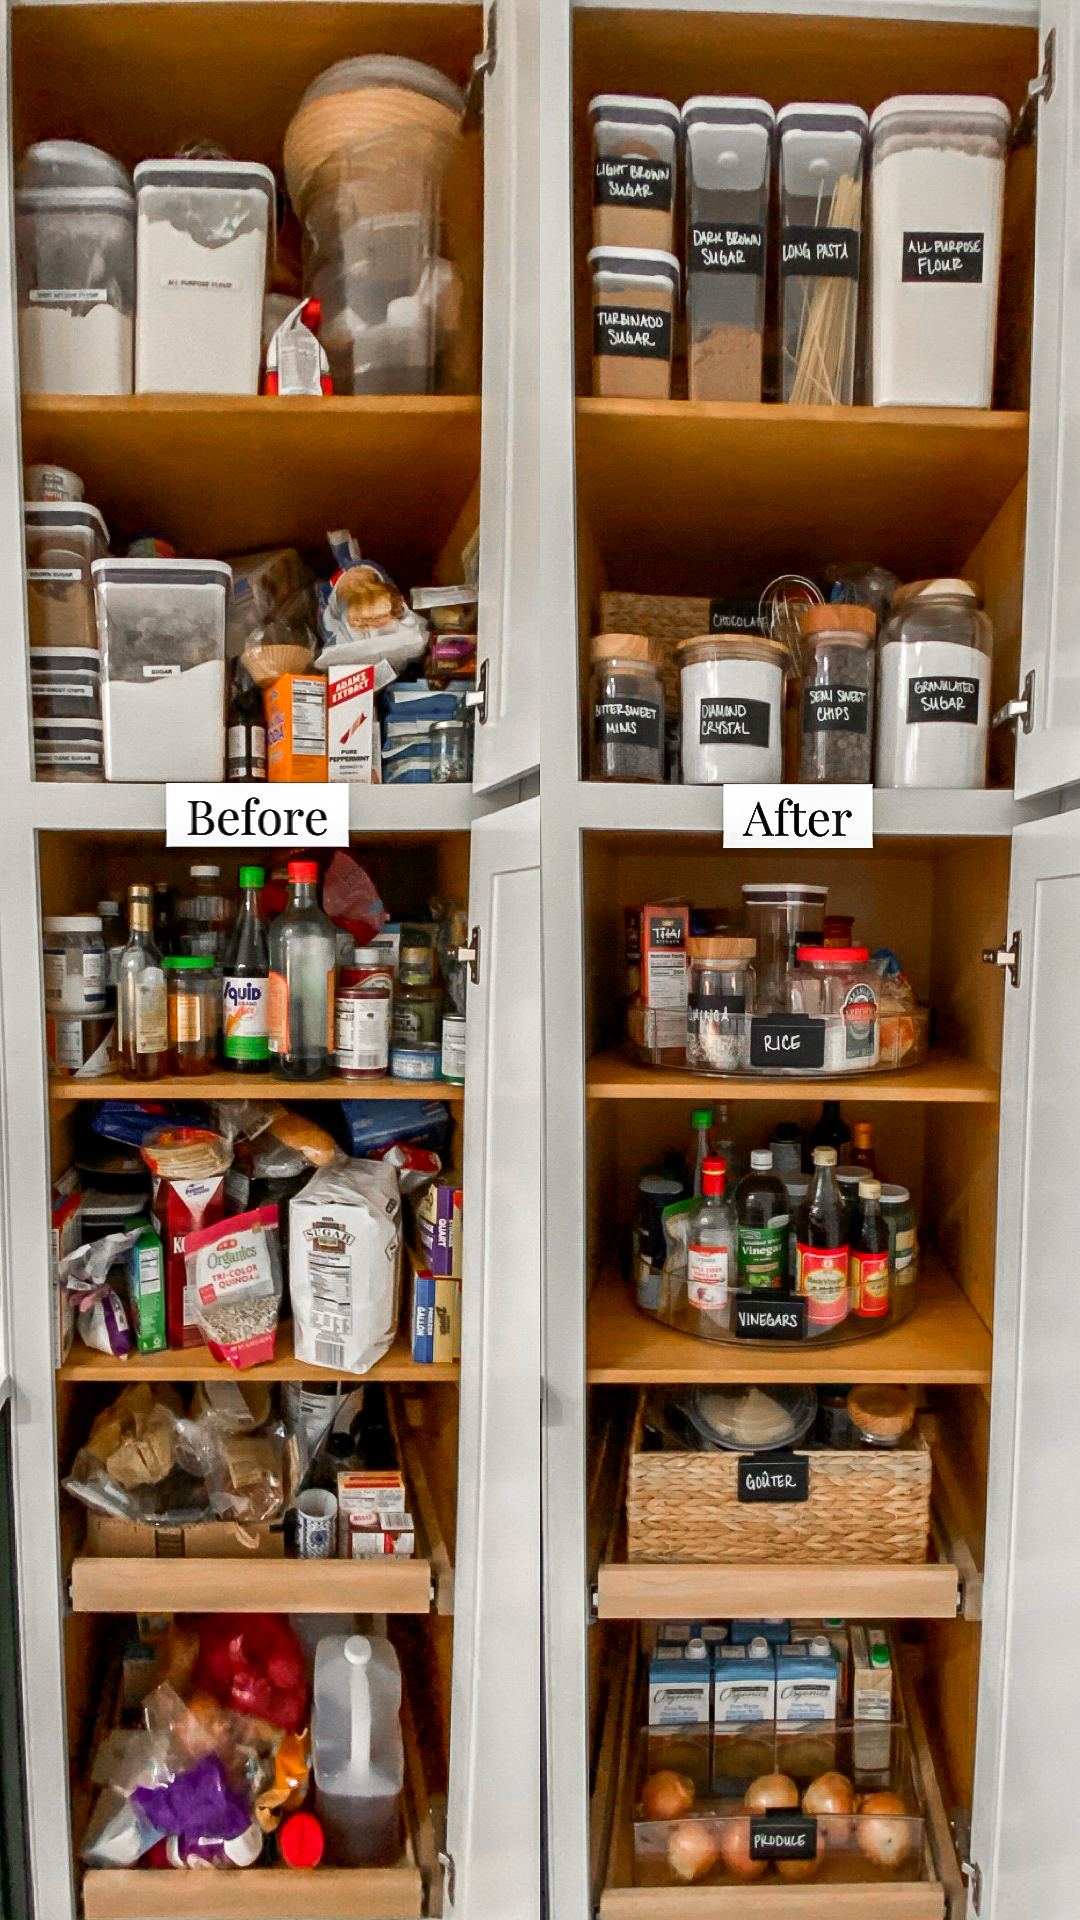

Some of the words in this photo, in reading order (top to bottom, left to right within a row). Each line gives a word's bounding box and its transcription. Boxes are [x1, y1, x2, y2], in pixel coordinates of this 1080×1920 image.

[596, 163, 628, 177] LIGHT
[629, 165, 670, 180] BROWN
[608, 181, 654, 198] SUGAR
[693, 229, 724, 246] DARK
[725, 230, 762, 247] BROWN
[908, 239, 933, 254] ALL
[933, 239, 982, 254] PURPOSE
[701, 248, 746, 266] SUGAR
[782, 243, 811, 262] LONG
[816, 242, 849, 260] PASTA
[917, 256, 964, 275] FLOUR
[598, 311, 664, 329] TURBINADO
[608, 328, 656, 347] SUGAR
[335, 670, 368, 693] ADAM'S
[914, 680, 976, 694] GRANULATED
[331, 678, 370, 704] EXTRACT
[809, 689, 833, 704] SEMI
[837, 689, 867, 703] SWEET
[701, 704, 748, 717] DIAMOND
[920, 696, 966, 712] SUGAR
[816, 706, 850, 722] CHIPS
[606, 721, 637, 735] MINIS
[701, 720, 751, 736] CRYSTAL
[329, 755, 370, 763] PEPPERMINT
[652, 927, 681, 940] THAI
[763, 1034, 801, 1053] RICE
[306, 1227, 352, 1244] SUGAR
[437, 1218, 447, 1248] QUART
[207, 1245, 258, 1270] Organics
[742, 1243, 782, 1257] Vinegar
[211, 1263, 258, 1282] TRI-COLOR
[218, 1274, 255, 1290] QUINOA
[416, 1305, 426, 1336] GALLON
[737, 1311, 799, 1328] VINEGARS
[745, 1470, 797, 1491] GOÛTER
[753, 1833, 807, 1849] PRODUCE
